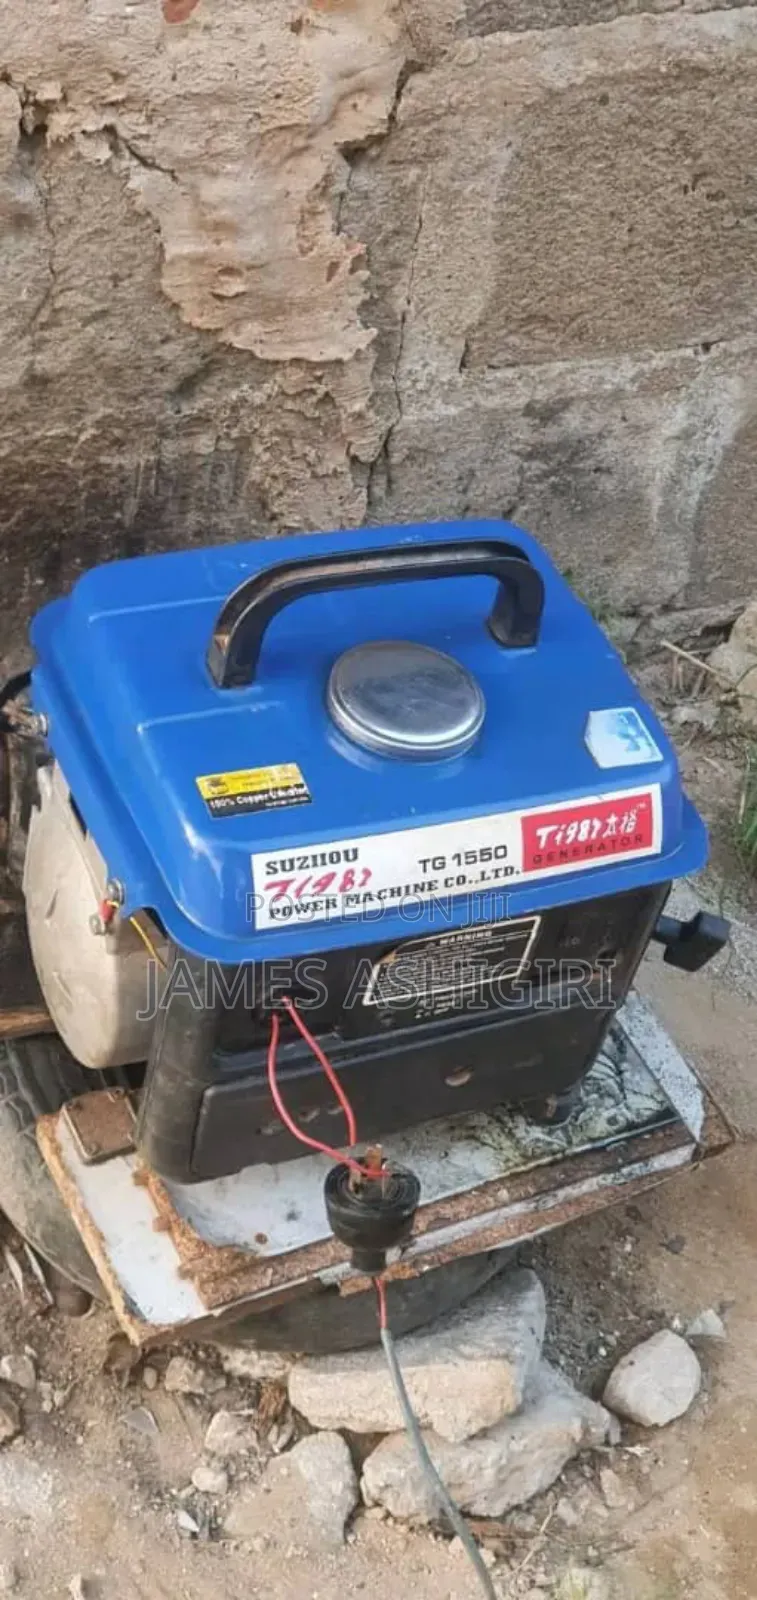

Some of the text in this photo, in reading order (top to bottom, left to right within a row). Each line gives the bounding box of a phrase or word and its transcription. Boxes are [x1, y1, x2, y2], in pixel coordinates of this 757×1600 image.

[418, 844, 509, 874] TG 1550
[532, 834, 644, 866] GENERATOR
[268, 896, 339, 920] POWER
[345, 879, 439, 908] MACHINE
[439, 930, 492, 945] WARNING
